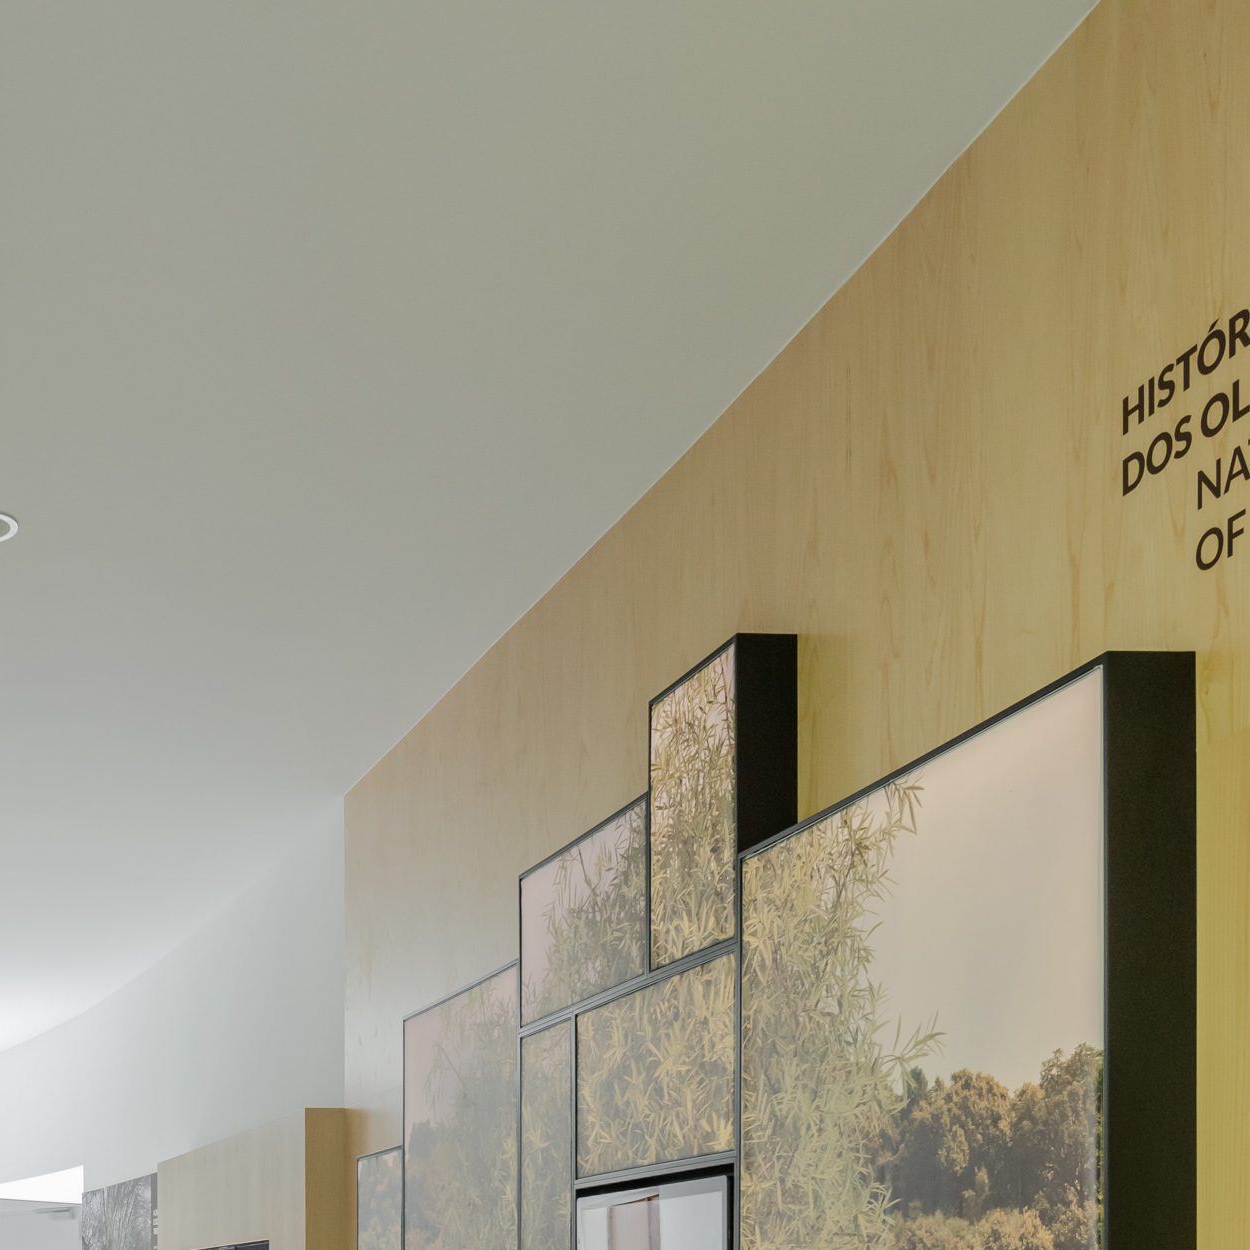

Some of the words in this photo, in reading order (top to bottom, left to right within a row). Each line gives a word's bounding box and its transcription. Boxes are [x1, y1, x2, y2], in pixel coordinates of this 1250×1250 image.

[1122, 309, 1250, 436] HISTÓR
[1122, 415, 1193, 497] DOS
[1200, 379, 1250, 438] OL
[1197, 438, 1250, 511] NA
[1196, 508, 1246, 571] OF
